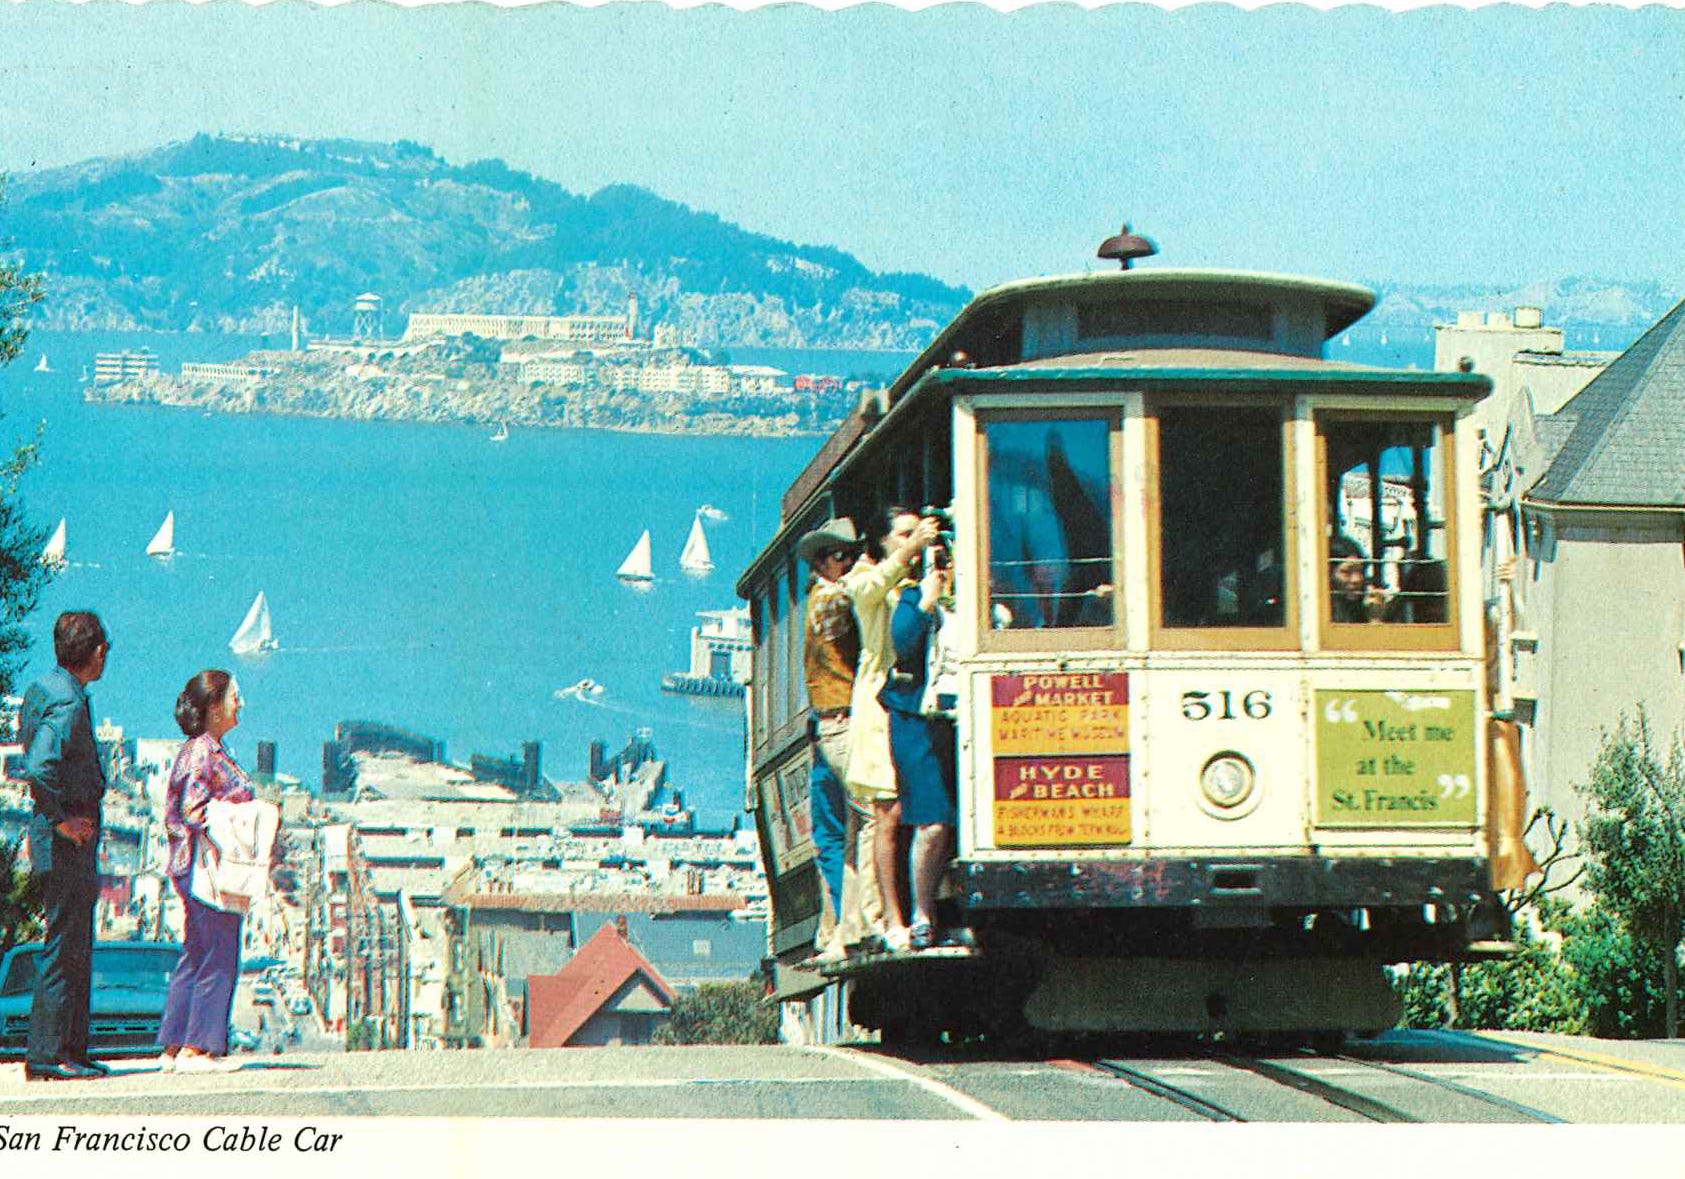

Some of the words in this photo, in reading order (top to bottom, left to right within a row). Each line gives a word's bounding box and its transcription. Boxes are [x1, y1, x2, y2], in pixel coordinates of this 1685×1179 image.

[1023, 675, 1105, 690] POWELL
[1034, 691, 1115, 706] MARKET
[1182, 690, 1272, 721] 516
[1424, 726, 1454, 742] me
[1020, 764, 1105, 780] HYDE
[1357, 759, 1377, 775] at
[1383, 754, 1416, 775] the
[1033, 783, 1115, 799] BEACH
[1363, 789, 1440, 811] Francis
